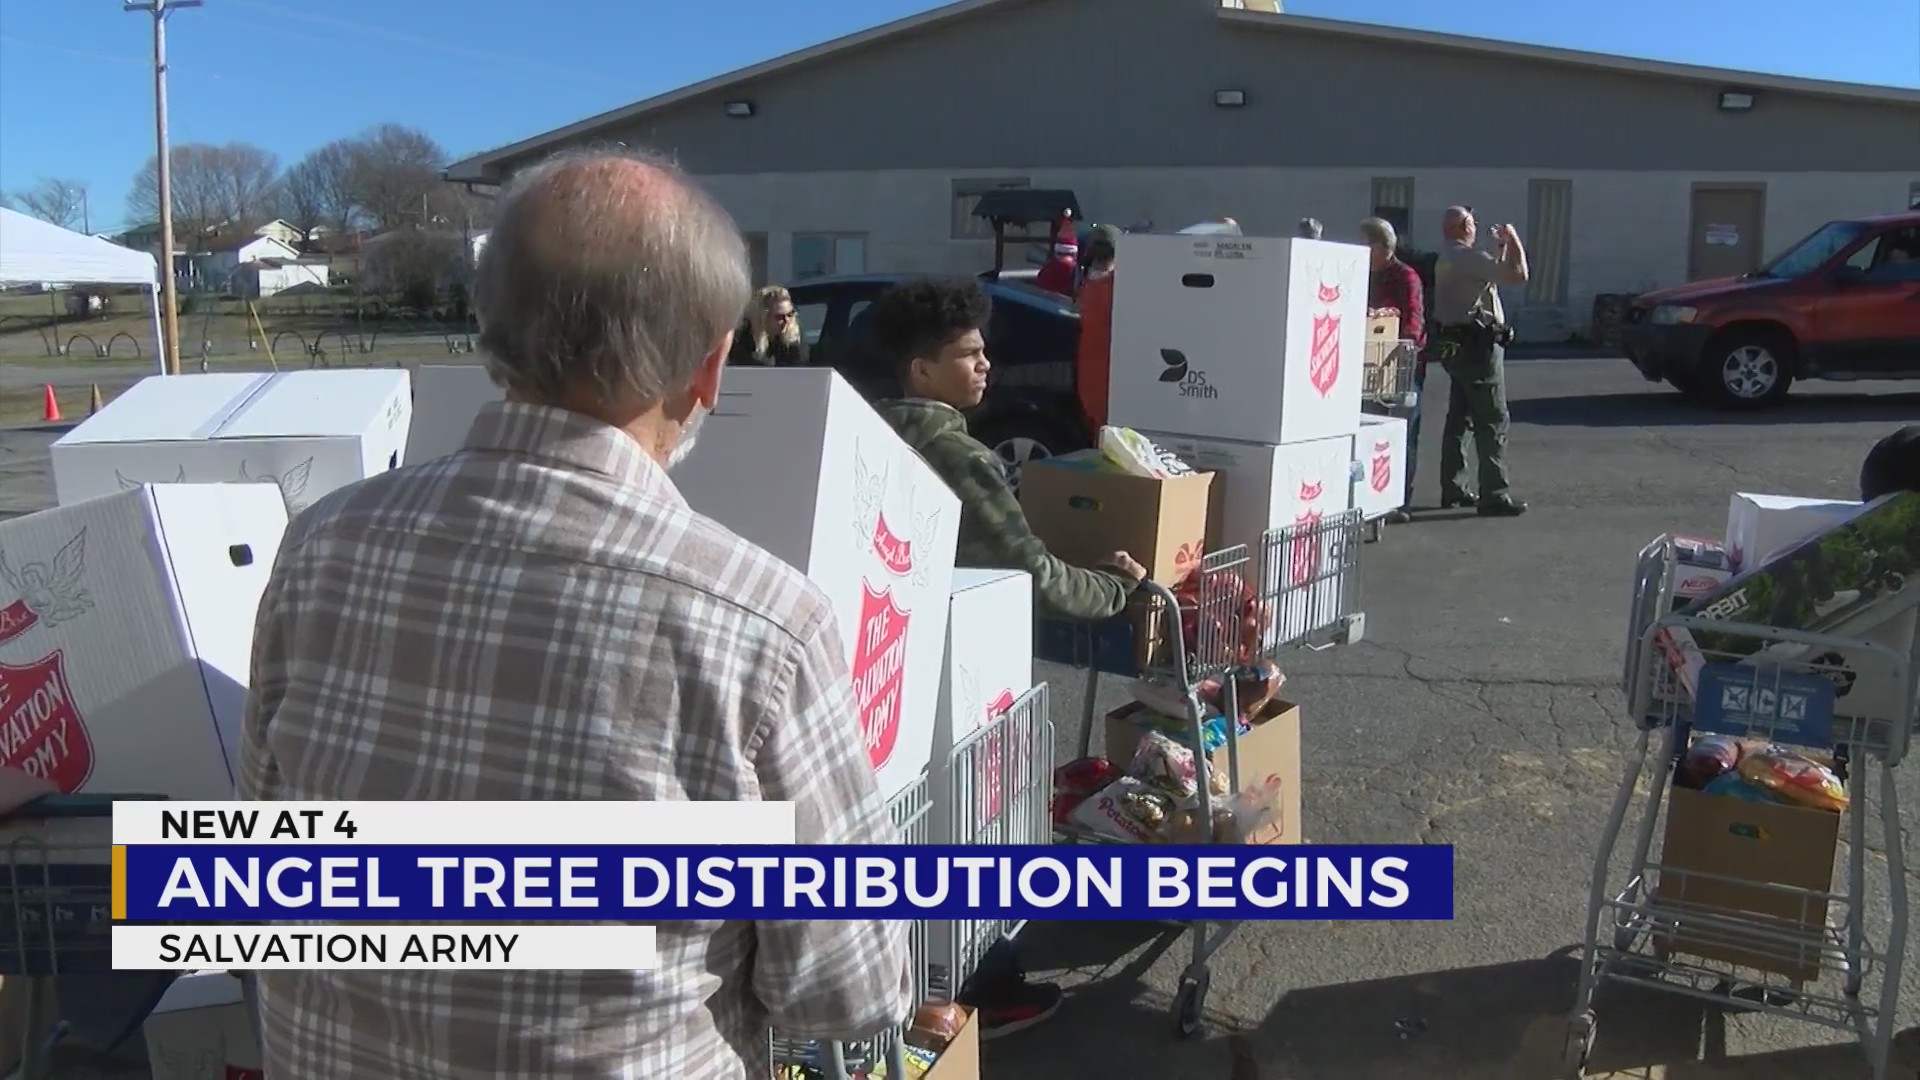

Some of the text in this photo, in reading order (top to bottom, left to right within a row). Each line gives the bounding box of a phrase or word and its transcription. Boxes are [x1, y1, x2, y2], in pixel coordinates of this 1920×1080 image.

[1178, 381, 1218, 399] Smith
[1187, 370, 1206, 385] DS
[866, 604, 891, 657] THE
[853, 626, 906, 712] SALVATION
[0, 670, 64, 767] VATION
[865, 679, 900, 751] ARMY
[22, 717, 69, 779] RMY
